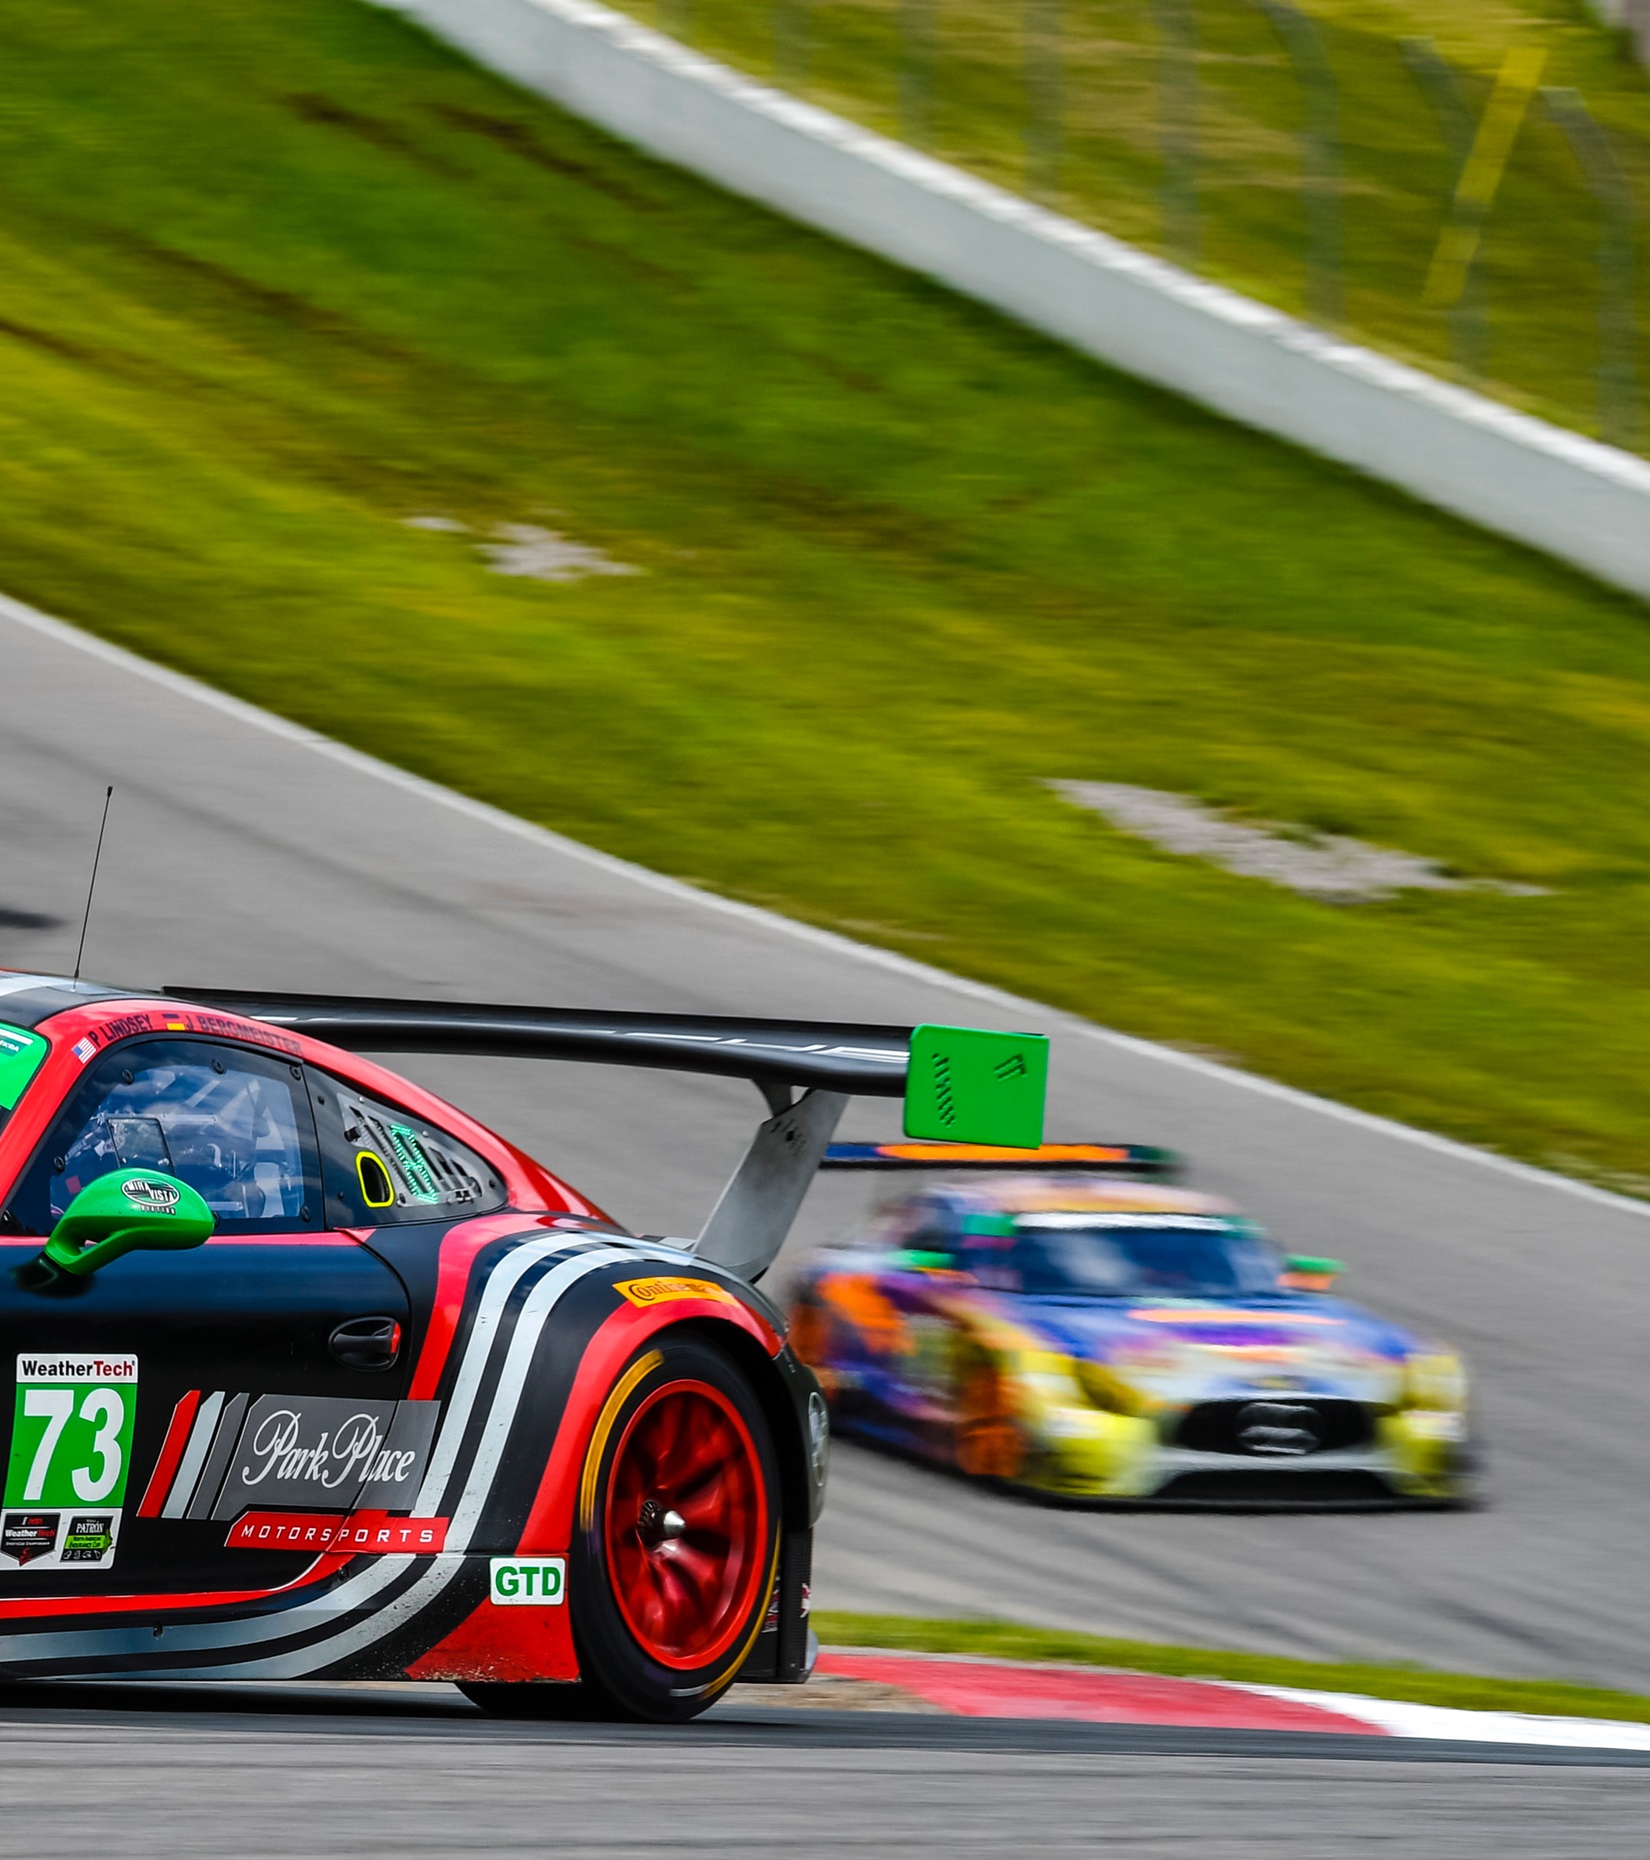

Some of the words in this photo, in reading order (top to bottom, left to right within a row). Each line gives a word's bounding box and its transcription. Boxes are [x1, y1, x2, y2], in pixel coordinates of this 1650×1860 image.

[87, 1030, 101, 1049] P
[100, 1014, 154, 1042] LINDSEY
[185, 1016, 195, 1031] J
[195, 1015, 306, 1057] BERGMEISTER
[129, 1181, 150, 1191] MIRA
[149, 1189, 176, 1202] VISTA
[22, 1360, 133, 1377] WeatherTech
[23, 1388, 124, 1502] 73
[242, 1409, 332, 1486] Park
[321, 1413, 416, 1489] Place
[241, 1524, 433, 1543] MOTORSPORTS
[495, 1566, 561, 1597] GTD
